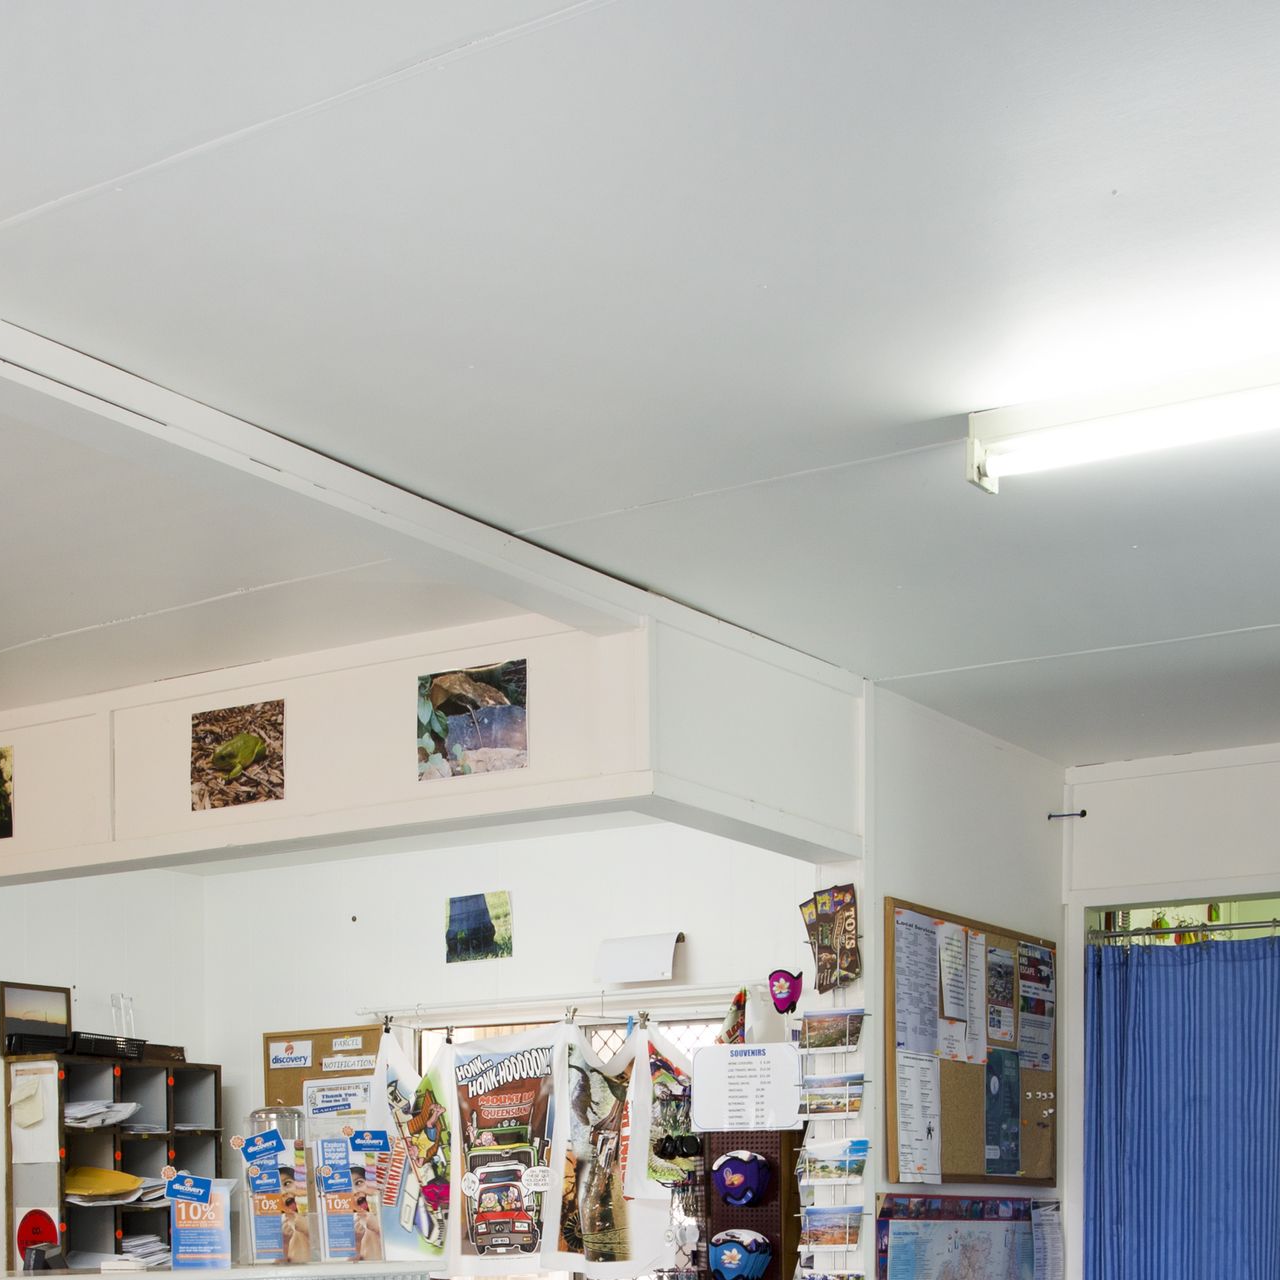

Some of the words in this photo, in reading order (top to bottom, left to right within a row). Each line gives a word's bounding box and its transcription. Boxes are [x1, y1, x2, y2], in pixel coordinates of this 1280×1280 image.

[845, 907, 856, 949] TOYS
[896, 920, 914, 928] Local
[914, 924, 936, 935] Services
[334, 1040, 359, 1048] PARCEL
[730, 1048, 766, 1058] SOUVENIRS
[272, 1055, 308, 1065] discovery
[324, 1059, 374, 1069] NOTIFICATION
[455, 1055, 493, 1081] HONK...
[479, 1092, 521, 1106] MOUNT
[172, 1183, 206, 1196] discovery
[178, 1202, 216, 1220] 10%
